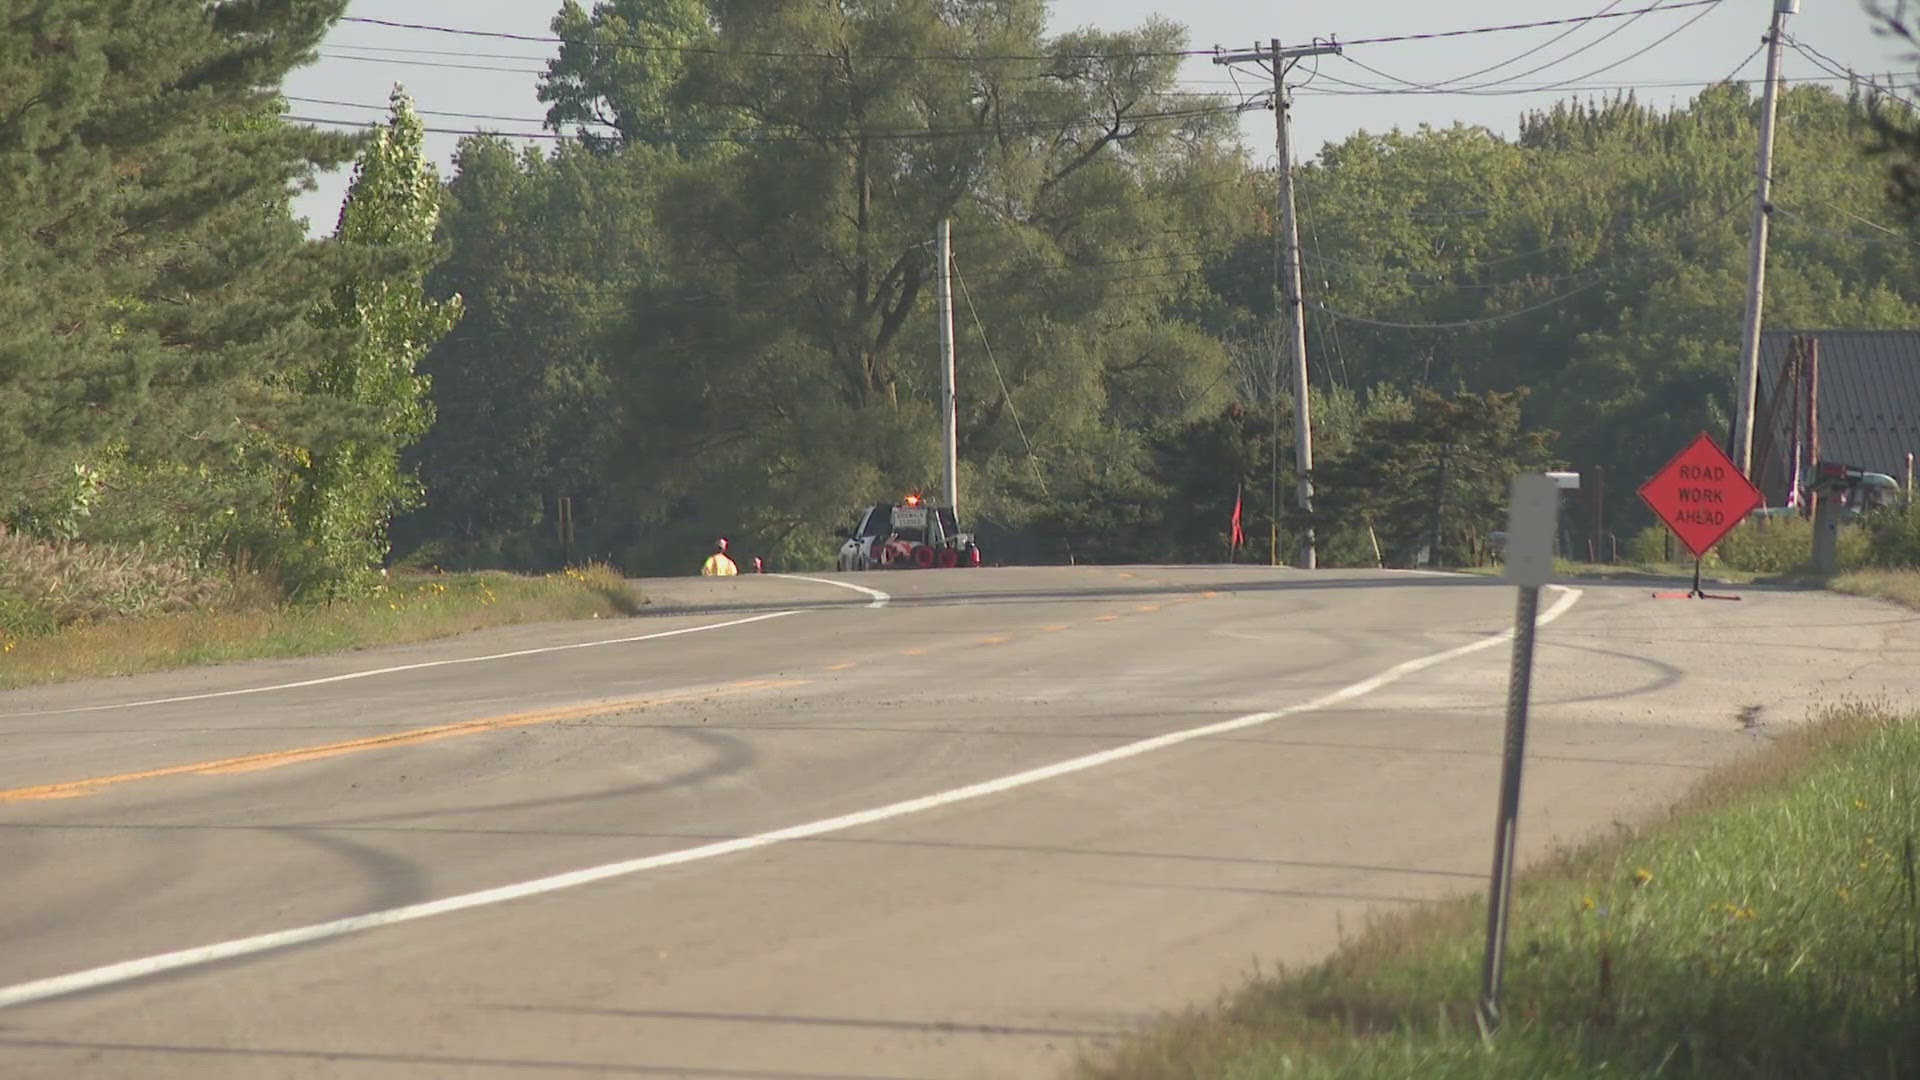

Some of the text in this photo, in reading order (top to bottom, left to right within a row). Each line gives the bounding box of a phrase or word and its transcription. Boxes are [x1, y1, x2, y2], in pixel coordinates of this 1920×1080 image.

[1680, 465, 1724, 480] ROAD
[1678, 487, 1723, 503] WORK
[1676, 510, 1724, 525] AHEAD
